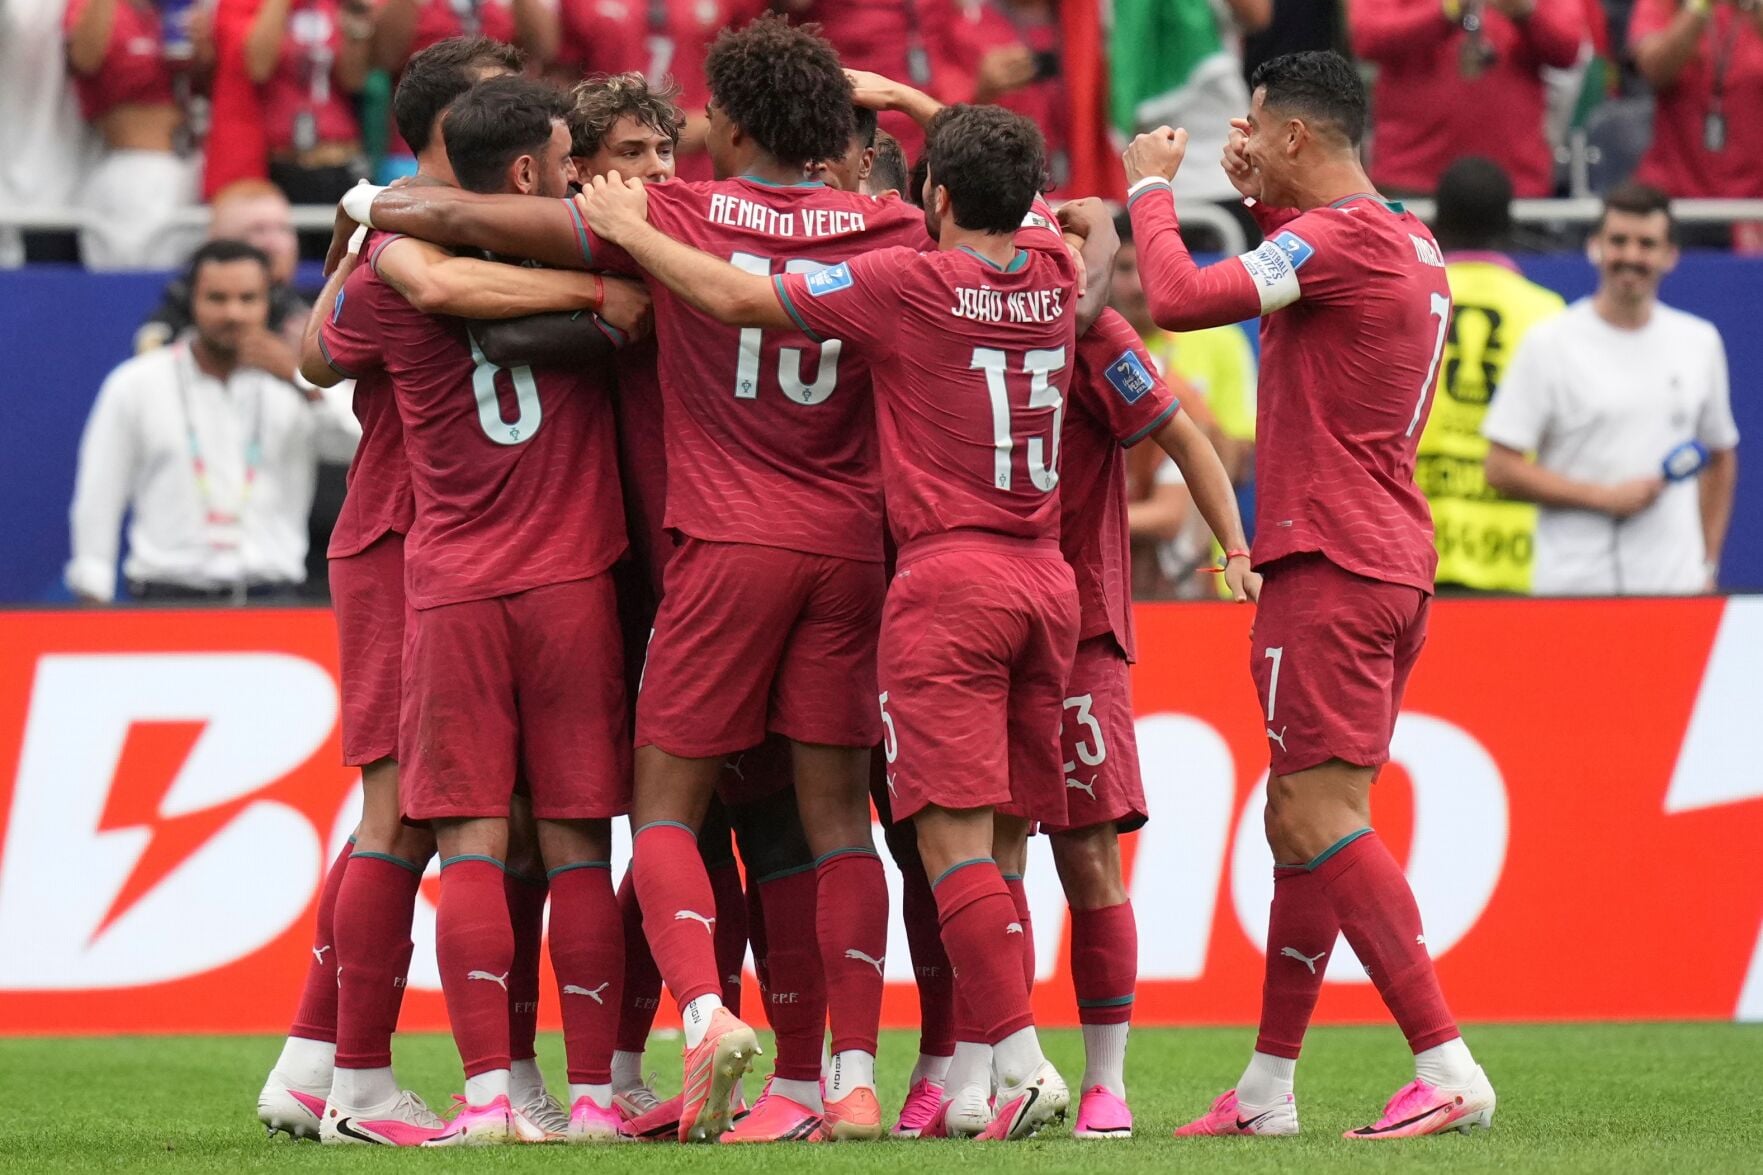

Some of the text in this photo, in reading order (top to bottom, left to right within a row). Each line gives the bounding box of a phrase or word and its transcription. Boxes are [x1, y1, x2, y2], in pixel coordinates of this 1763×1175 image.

[708, 193, 794, 237] RENATO
[951, 285, 1063, 323] JOÃO NEVES
[1405, 292, 1450, 438] 7
[969, 344, 1066, 493] 15
[1265, 646, 1283, 722] 7
[1059, 693, 1107, 773] 3
